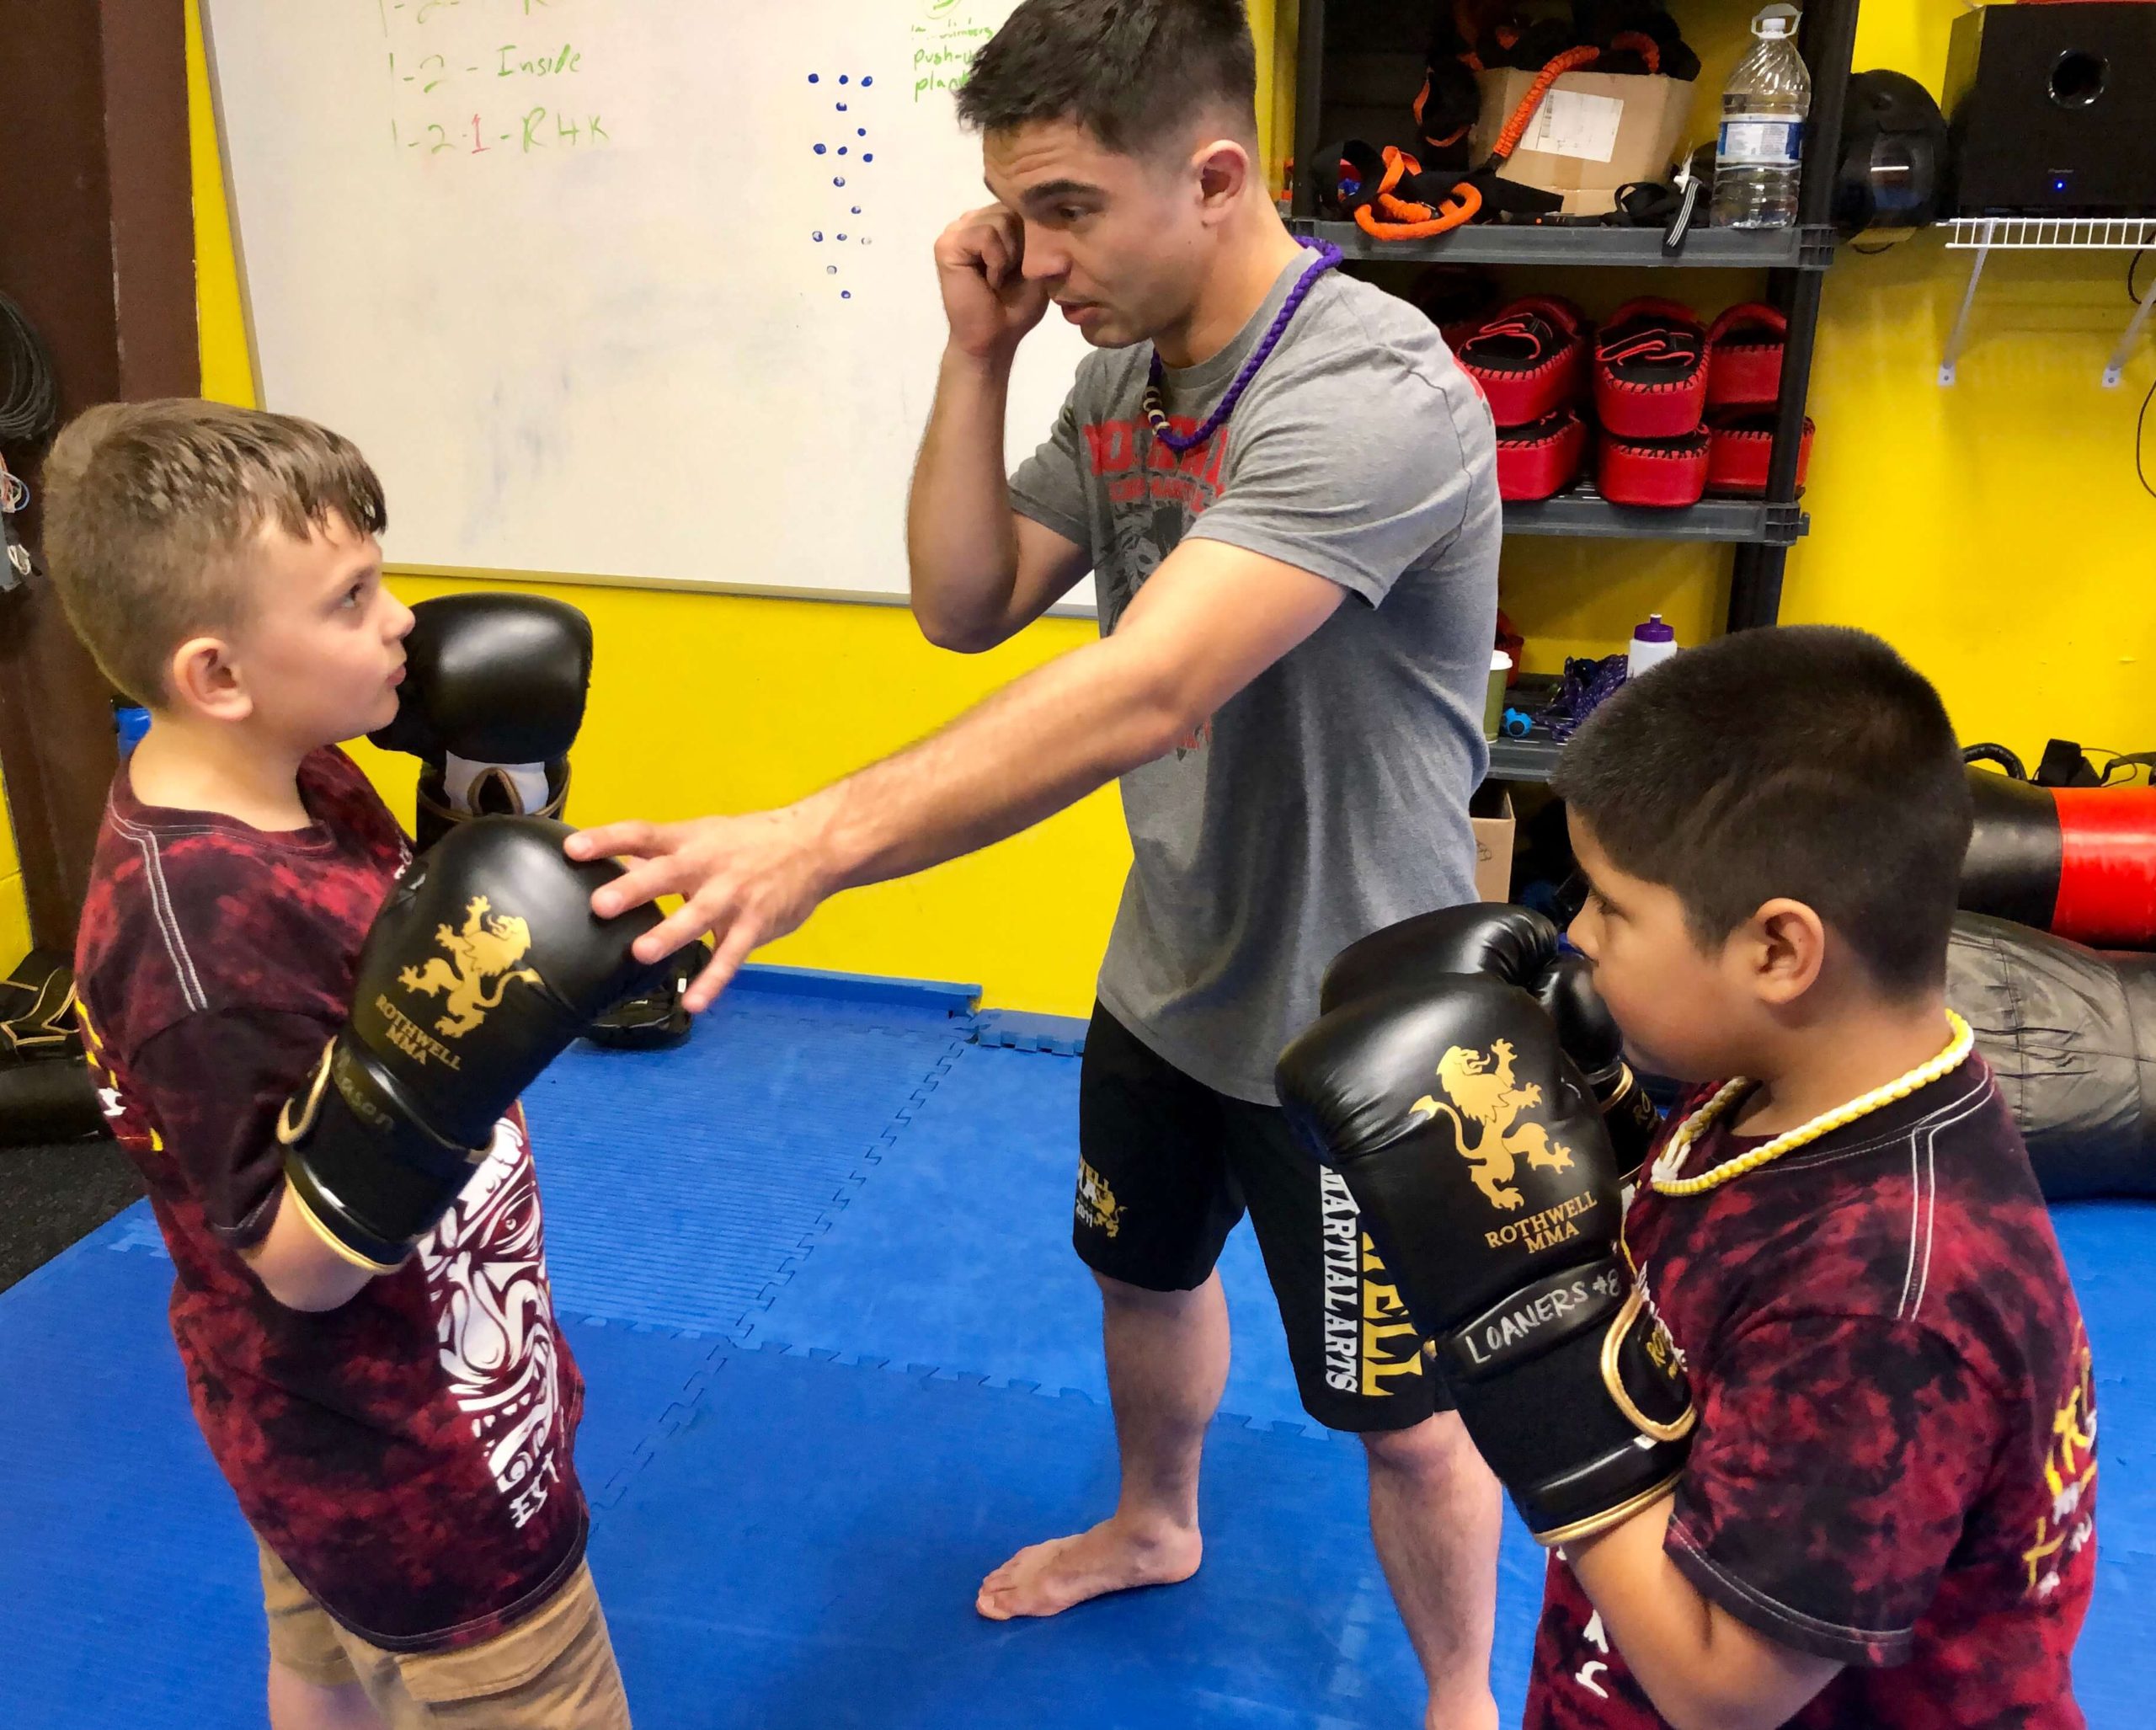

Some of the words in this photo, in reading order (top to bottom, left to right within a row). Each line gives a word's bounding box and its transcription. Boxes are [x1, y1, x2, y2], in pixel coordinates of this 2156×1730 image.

[496, 43, 581, 77] Inside
[376, 994, 462, 1071] ROTHWELL
[385, 1024, 427, 1065] MMA
[1484, 1190, 1598, 1248] ROTHWELL
[1524, 1220, 1580, 1253] MMA
[1465, 1280, 1590, 1364] LOANERS
